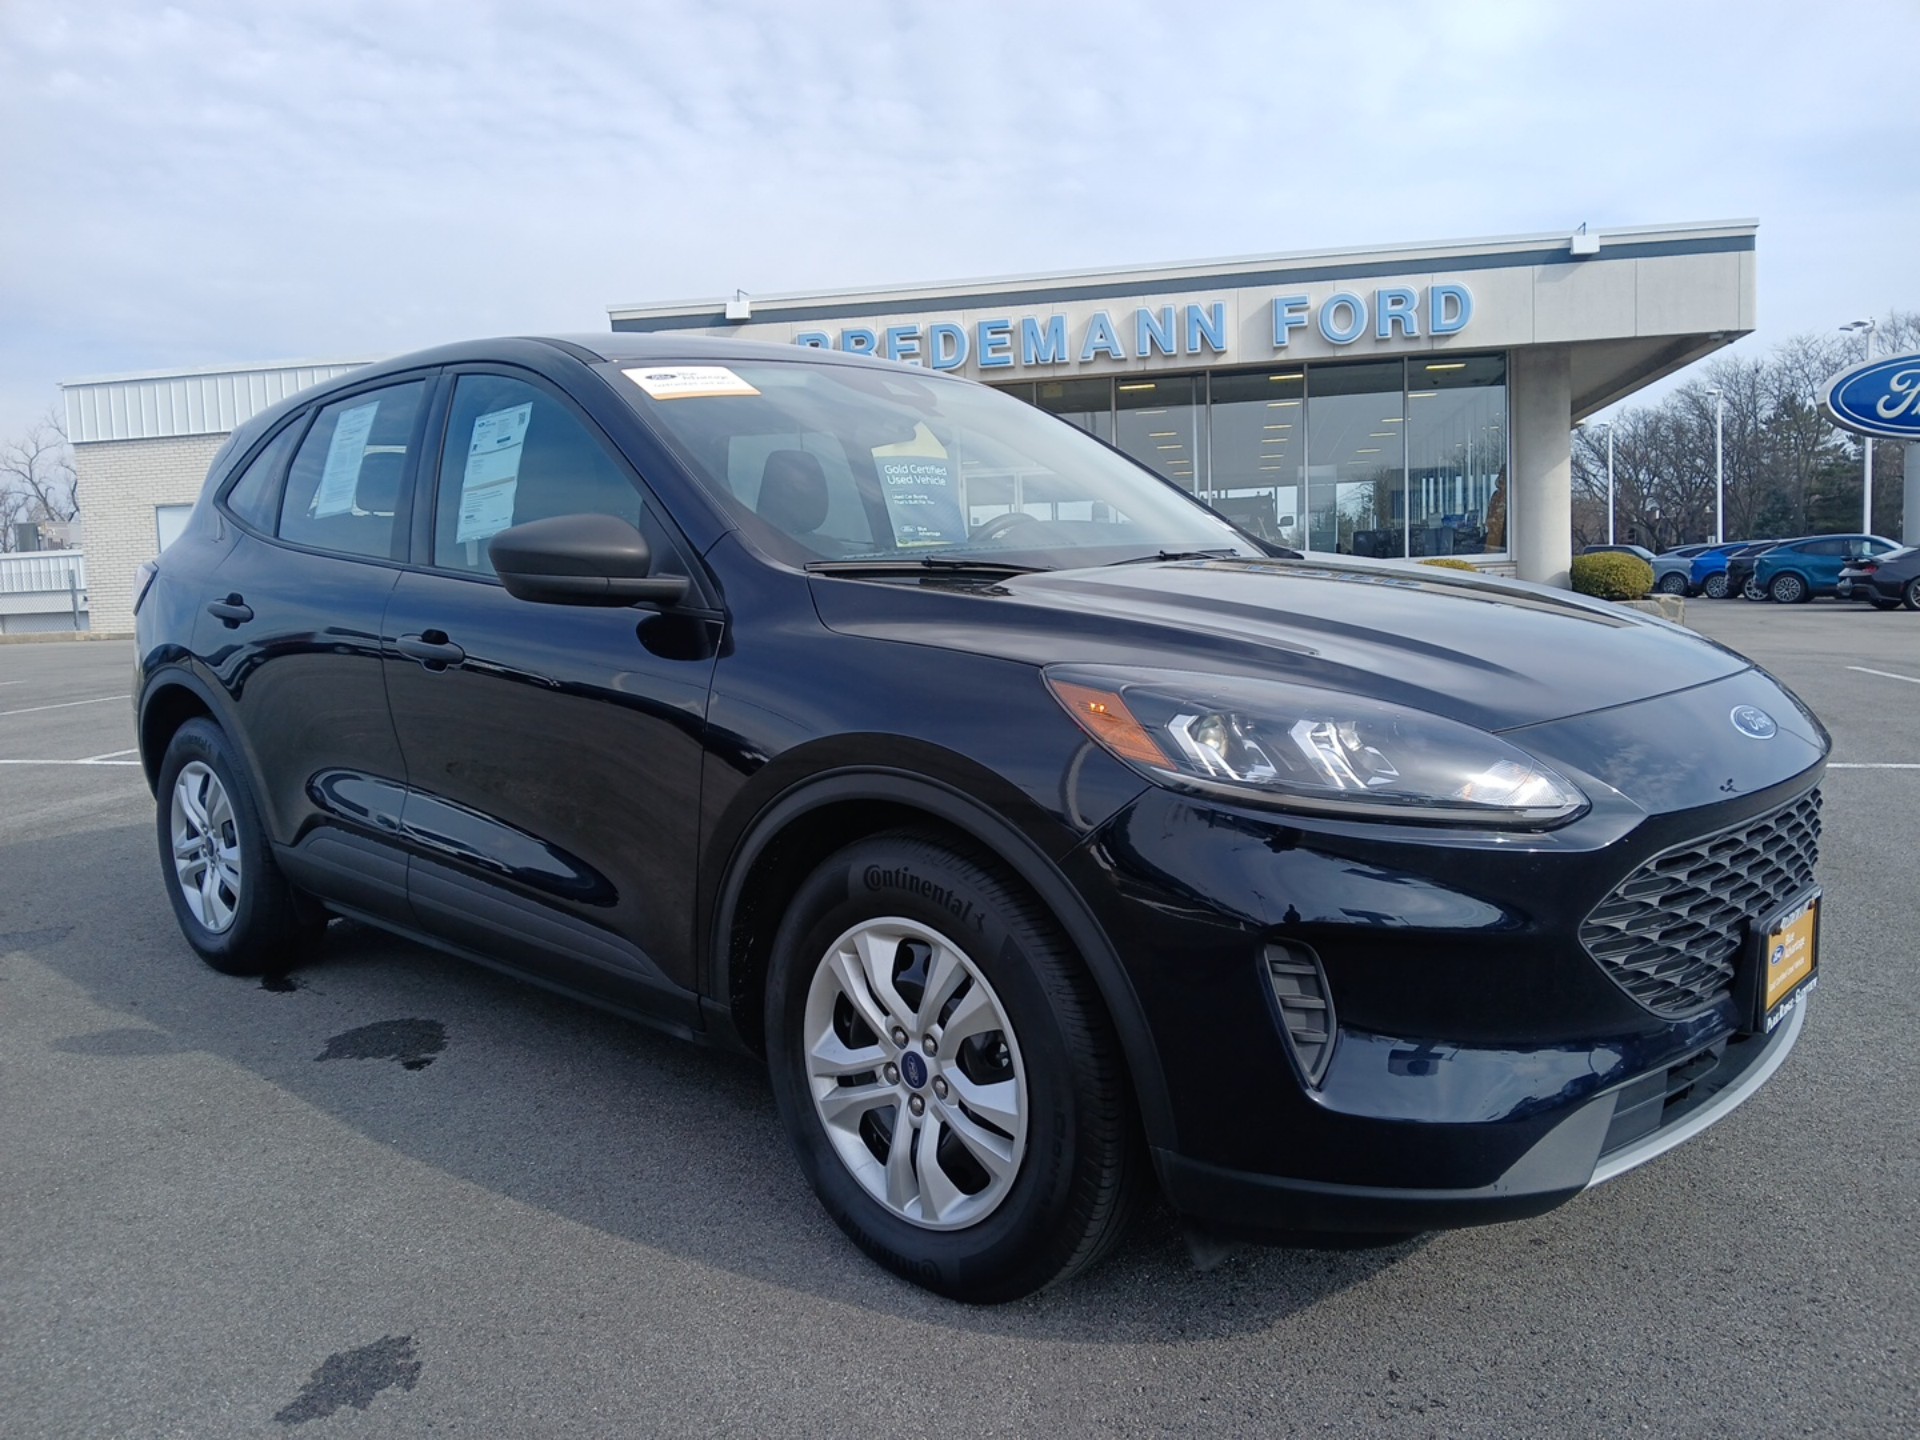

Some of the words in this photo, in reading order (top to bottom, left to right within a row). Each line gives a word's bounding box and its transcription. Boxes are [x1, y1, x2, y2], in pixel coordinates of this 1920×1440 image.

[1271, 281, 1475, 349] FORD
[884, 464, 908, 474] Gold
[909, 464, 947, 476] Certified
[887, 475, 913, 485] Used
[914, 475, 946, 486] Vehicle
[863, 863, 974, 922] Continental
